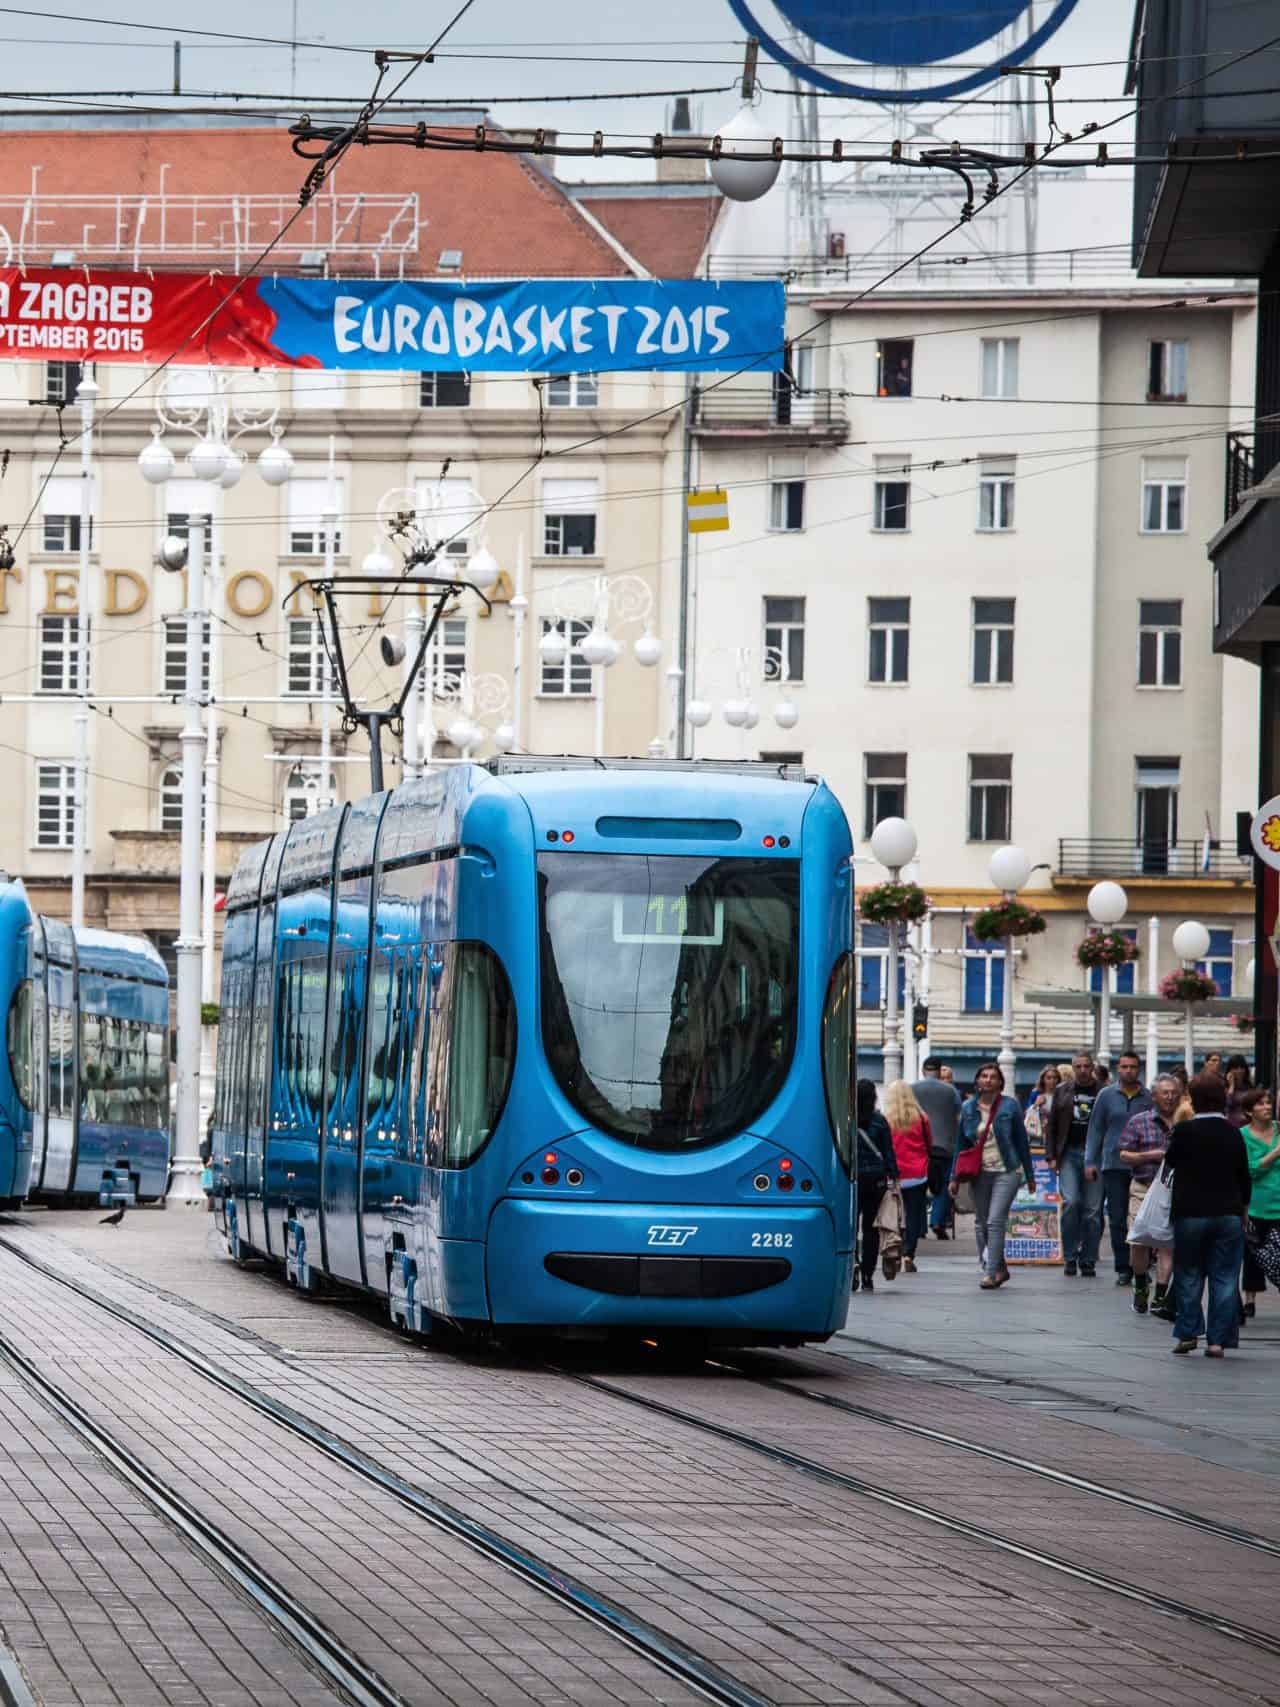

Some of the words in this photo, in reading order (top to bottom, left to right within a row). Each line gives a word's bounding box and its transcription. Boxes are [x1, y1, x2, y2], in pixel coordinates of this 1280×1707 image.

[19, 282, 153, 323] ZAGREB
[93, 327, 144, 352] 2015
[634, 305, 731, 355] 2015
[648, 895, 688, 934] 11
[647, 1225, 699, 1246] ZET
[751, 1232, 794, 1248] 2282
